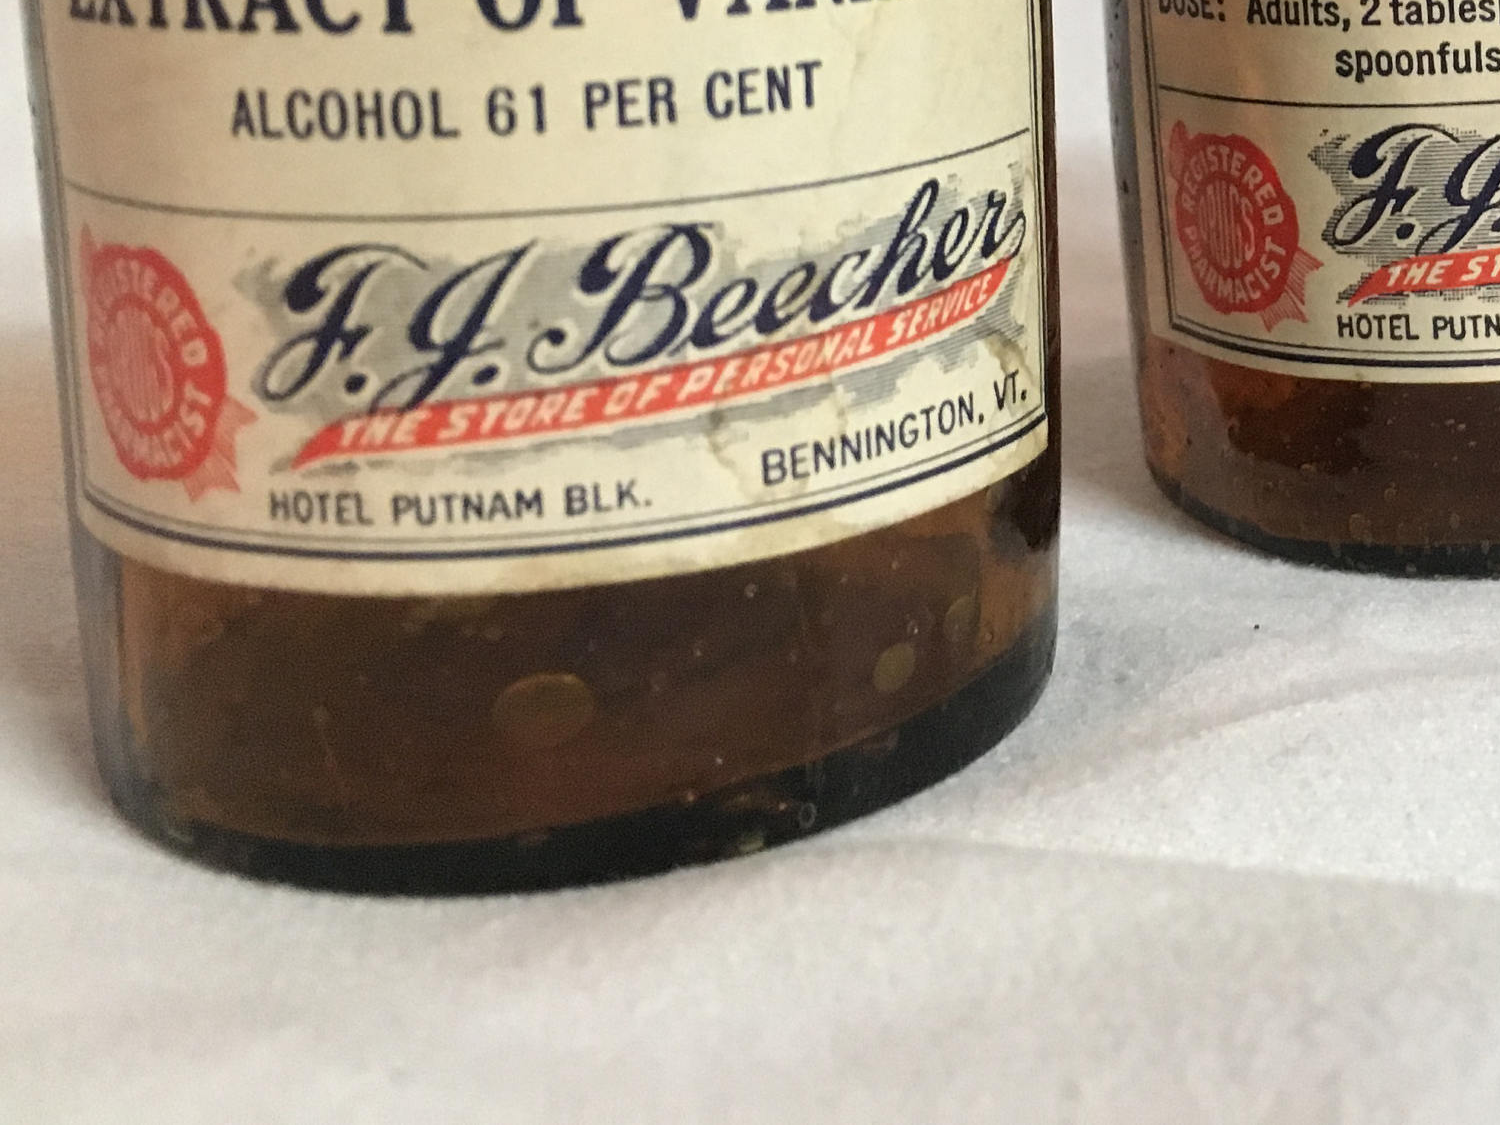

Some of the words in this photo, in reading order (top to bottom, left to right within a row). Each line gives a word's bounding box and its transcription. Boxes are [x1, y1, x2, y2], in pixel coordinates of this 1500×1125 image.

[232, 88, 460, 141] ALCOHOL
[486, 82, 548, 136] 61
[584, 77, 678, 131] PER
[705, 61, 823, 120] CENT
[527, 177, 1027, 376] Beecher
[1386, 258, 1453, 288] THE
[1336, 313, 1420, 341] HOTEL
[338, 410, 432, 448] THE
[446, 385, 599, 442] STORE
[602, 376, 676, 417] OF
[677, 330, 874, 404] PERSONAL
[885, 270, 996, 347] SERVICE
[993, 369, 1028, 412] VT.
[268, 489, 375, 527] HOTEL
[391, 487, 545, 528] PUTNAM
[564, 479, 653, 518] BLK.
